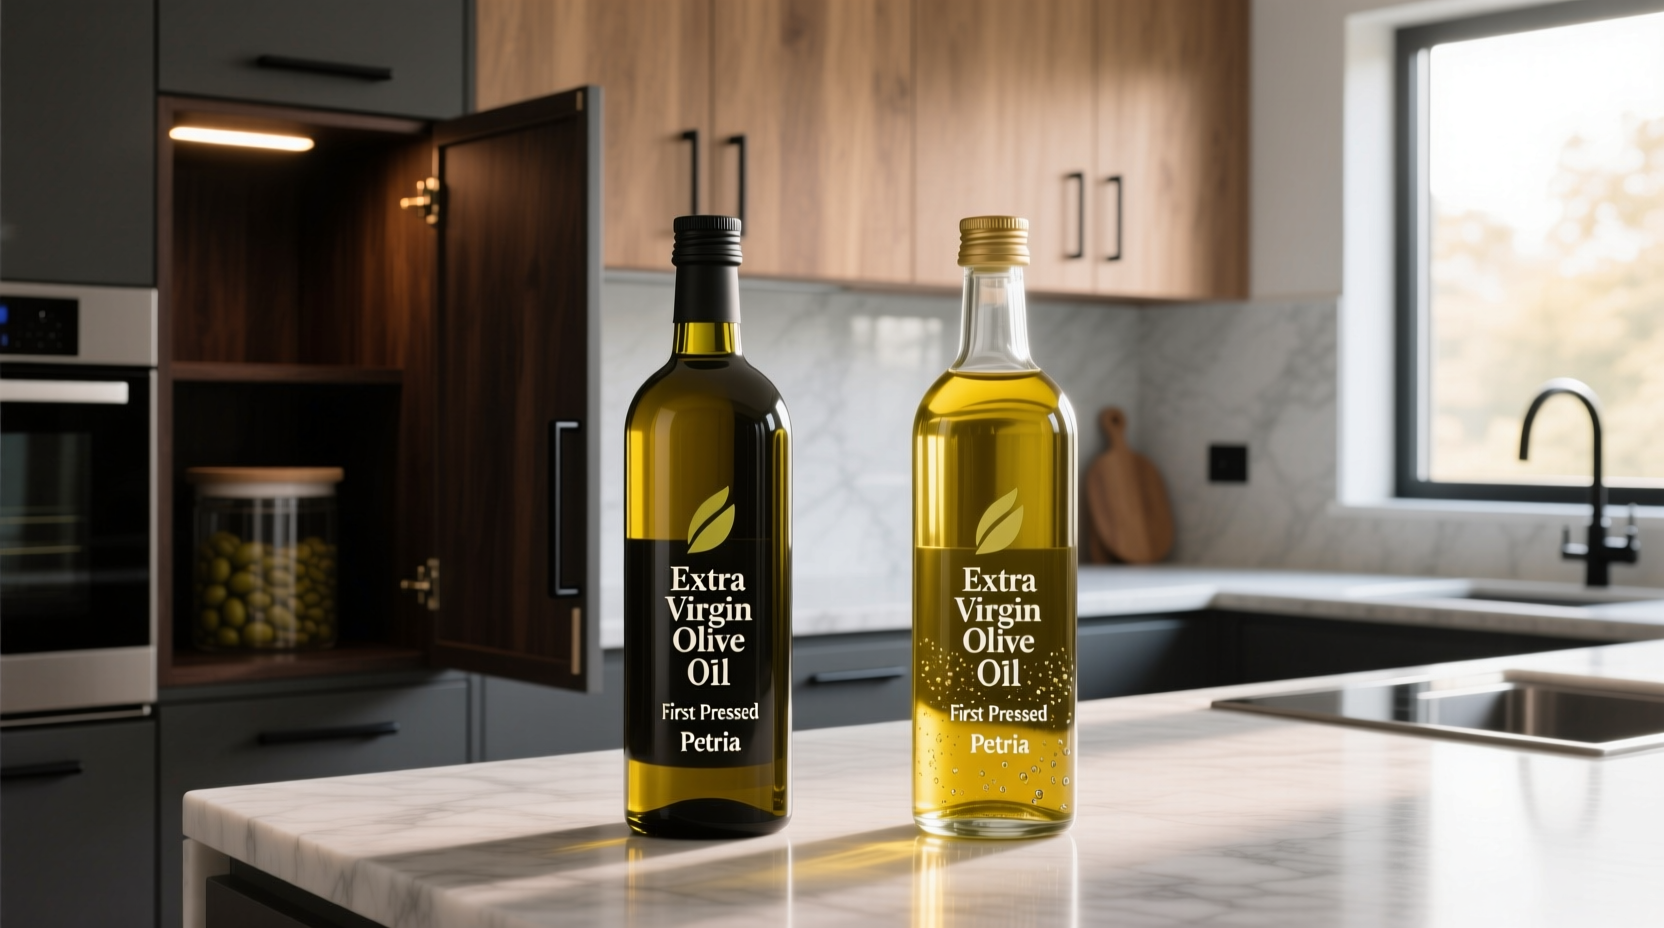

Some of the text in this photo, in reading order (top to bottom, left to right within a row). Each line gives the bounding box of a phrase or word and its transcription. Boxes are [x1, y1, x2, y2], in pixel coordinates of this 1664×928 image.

[670, 566, 746, 591] Extra
[962, 567, 1038, 592] Extra
[664, 596, 753, 628] Virgin
[954, 597, 1042, 629] Virgin
[672, 626, 745, 652] Olive
[962, 627, 1035, 653] Olive
[687, 658, 731, 686] Oil
[977, 659, 1022, 687] Oil
[661, 702, 760, 720] First Pressed
[950, 704, 1048, 722] First Pressed
[680, 731, 742, 752] Petria
[970, 733, 1030, 754] Petria
